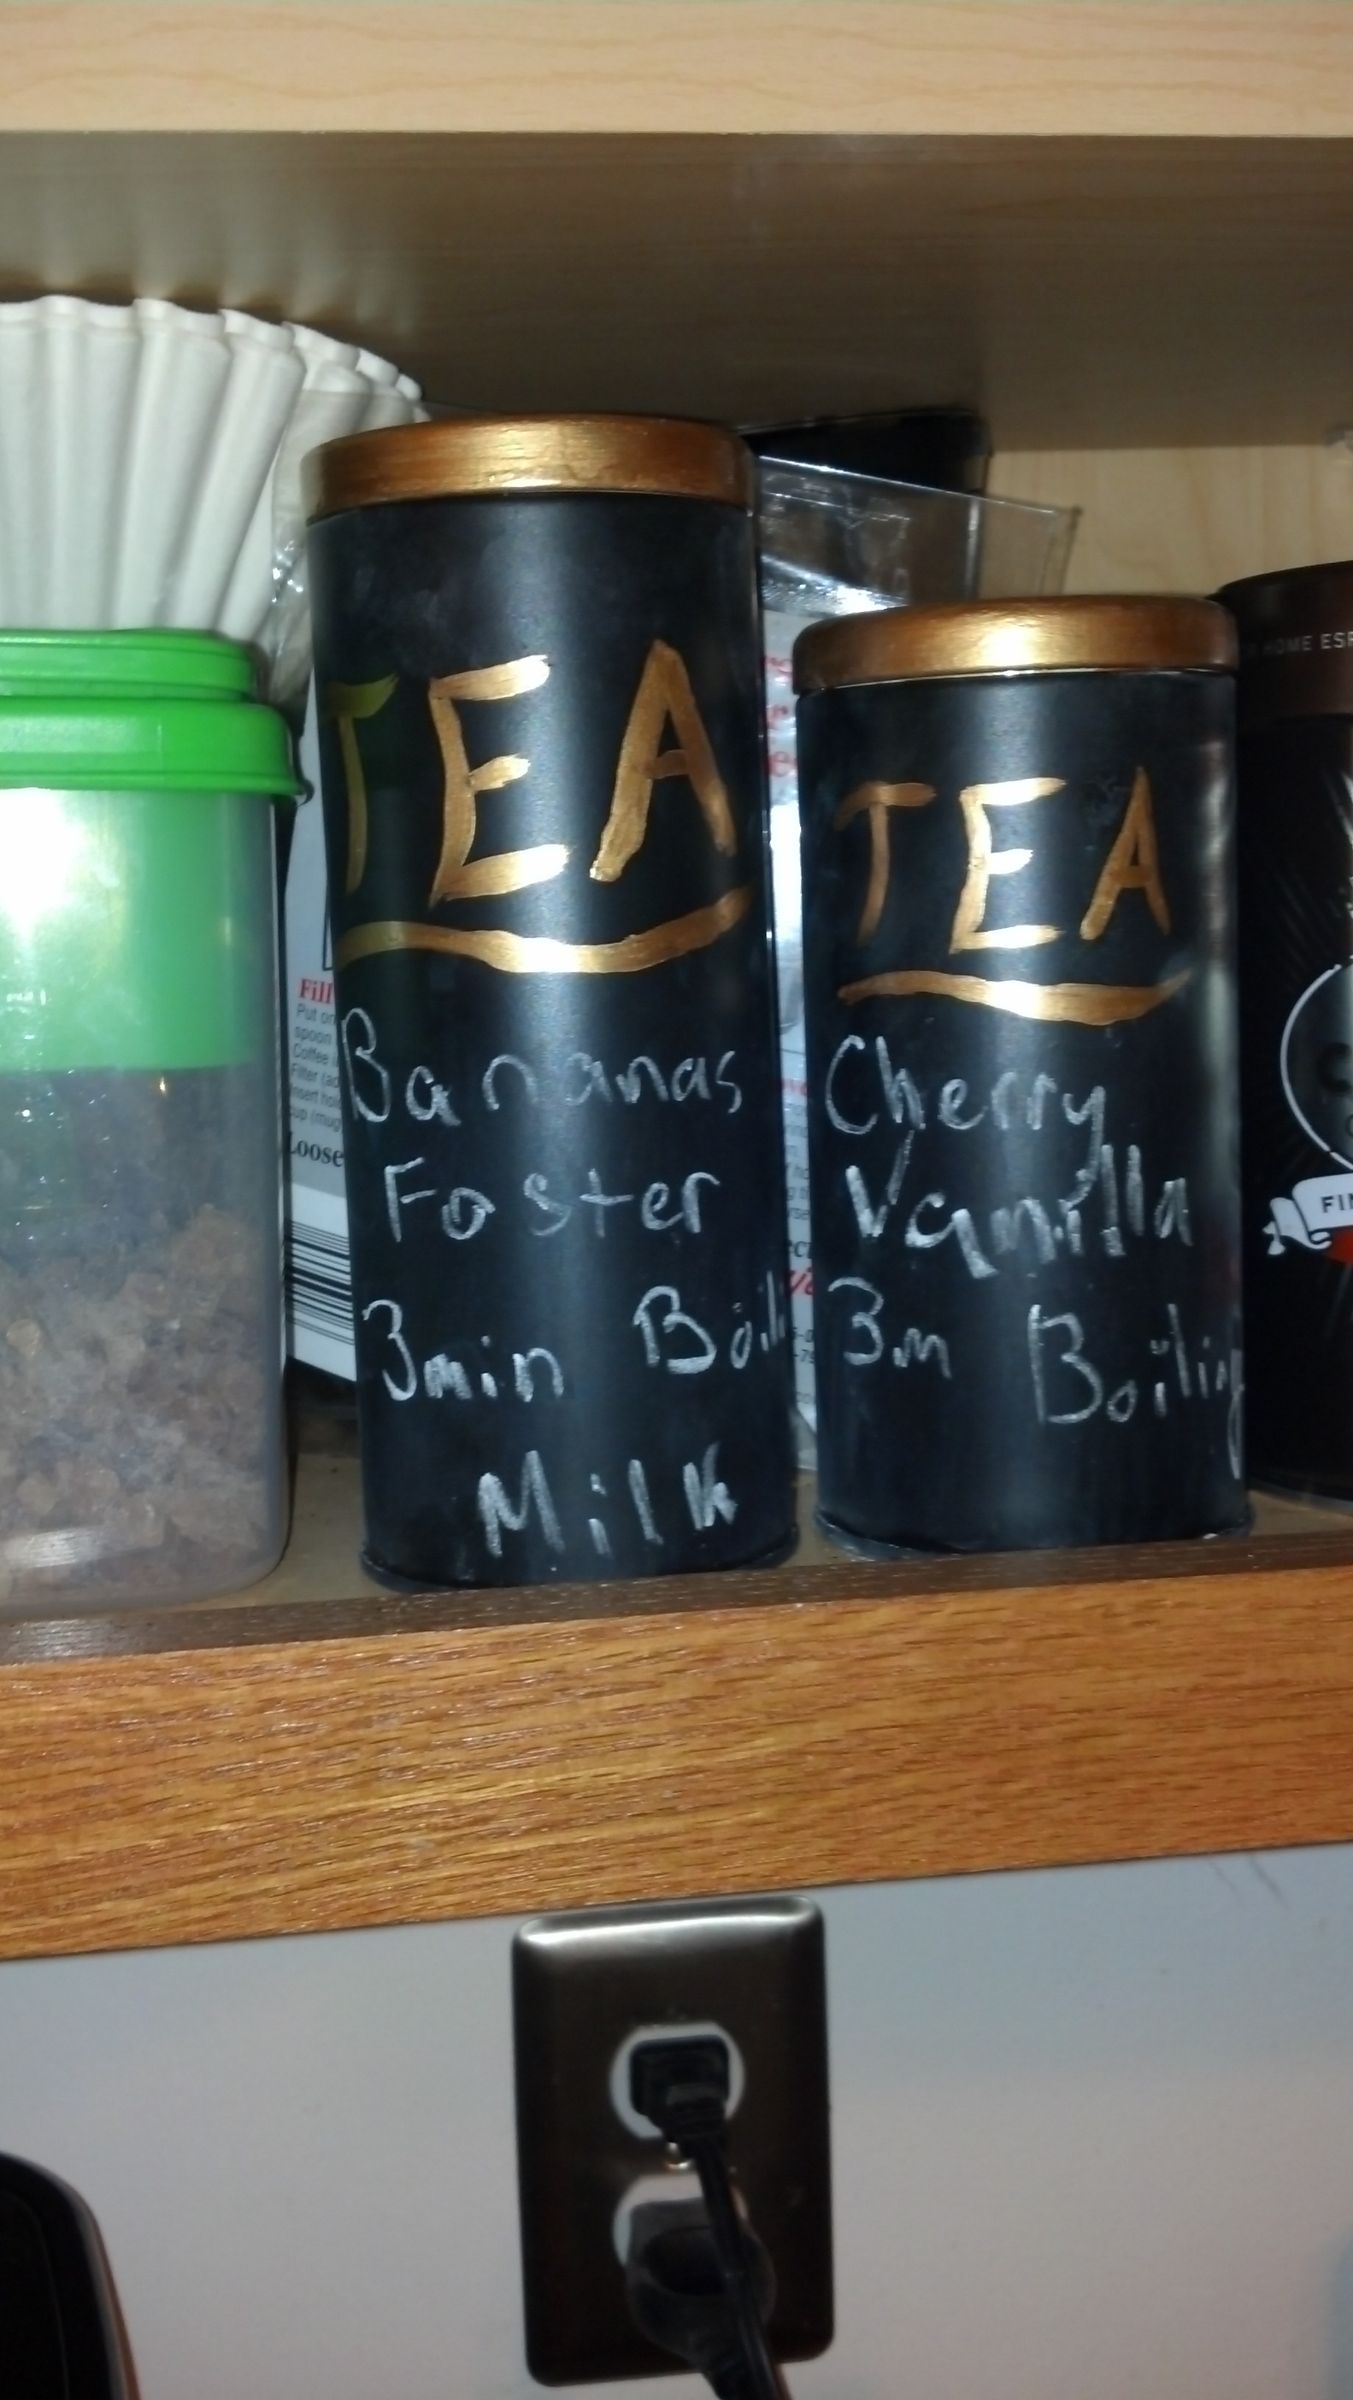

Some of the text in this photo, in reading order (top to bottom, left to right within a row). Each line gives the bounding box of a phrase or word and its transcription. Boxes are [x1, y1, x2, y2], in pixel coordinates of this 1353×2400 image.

[327, 638, 737, 911] TEA
[834, 766, 1173, 954] TEA
[294, 1026, 332, 1046] spoon
[294, 1042, 329, 1066] Coffee
[297, 1002, 318, 1021] Put
[342, 1007, 743, 1126] Bananas
[825, 1035, 1107, 1210] Cherry
[384, 1157, 721, 1243] Foster
[846, 1130, 1195, 1279] Vanilla
[477, 1441, 739, 1558] Milk
